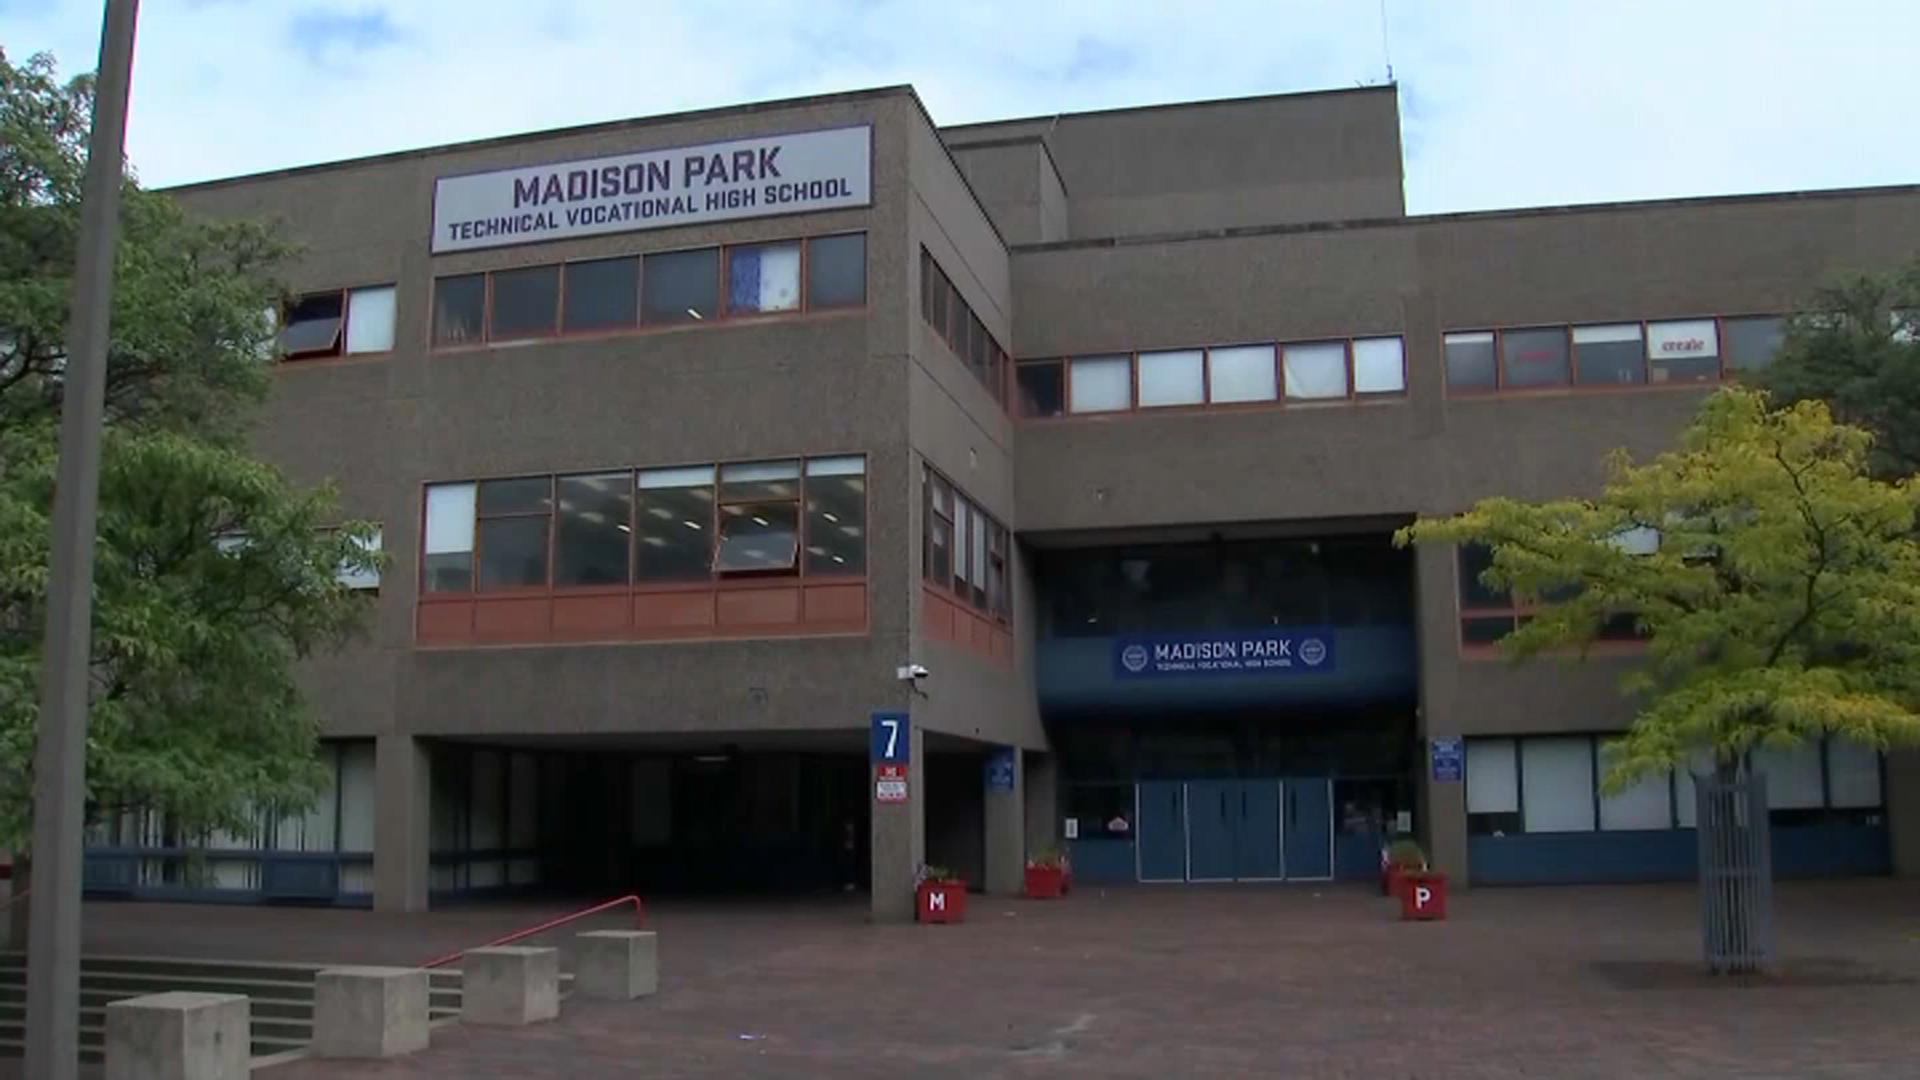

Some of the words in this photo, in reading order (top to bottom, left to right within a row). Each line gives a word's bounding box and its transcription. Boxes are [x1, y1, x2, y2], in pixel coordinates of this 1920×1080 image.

[513, 159, 671, 209] MADISON
[684, 146, 782, 186] PARK
[449, 213, 559, 241] TECHNICAL
[567, 196, 698, 226] VOCATIONAL
[706, 188, 756, 211] HIGH
[764, 177, 852, 204] SCHOOL
[1662, 338, 1705, 352] create
[1155, 641, 1236, 661] MADISON
[1242, 639, 1292, 657] PARK
[880, 719, 898, 758] 7
[929, 892, 945, 911] M
[1415, 887, 1431, 909] P
